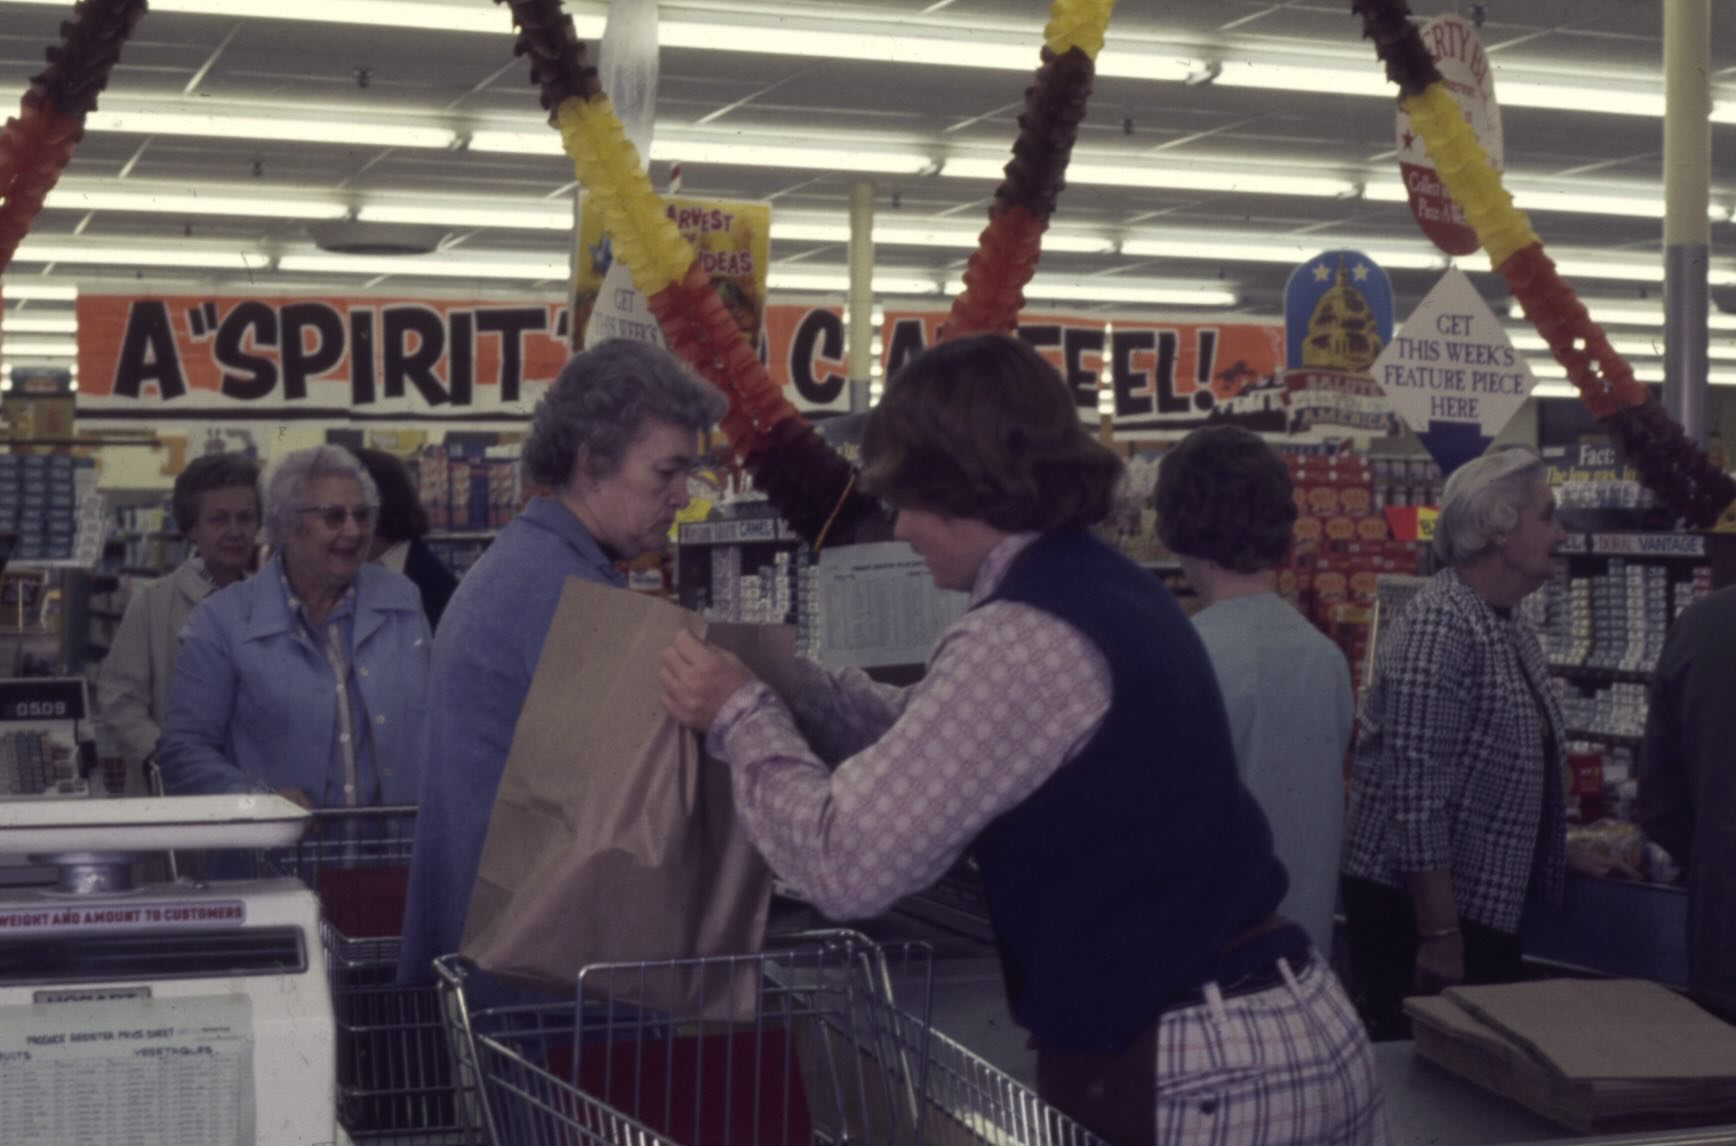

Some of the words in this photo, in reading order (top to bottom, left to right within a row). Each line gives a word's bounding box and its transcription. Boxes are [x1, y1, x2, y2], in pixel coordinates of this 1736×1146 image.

[667, 204, 733, 232] ARVEST
[1436, 314, 1475, 336] GET
[112, 301, 186, 400] A
[1396, 337, 1440, 361] THIS
[1446, 341, 1515, 367] WEEK'S
[1384, 364, 1466, 391] FEATURE
[1471, 370, 1525, 394] PIECE
[1431, 395, 1480, 418] HERE
[1578, 443, 1616, 467] Fact:
[1637, 534, 1698, 554] VANTAGE
[0, 912, 49, 926] WEIGHT
[51, 911, 80, 925] AND
[83, 908, 140, 924] AMOUNT
[145, 909, 162, 921] TO
[164, 906, 243, 922] CUSTOMERS
